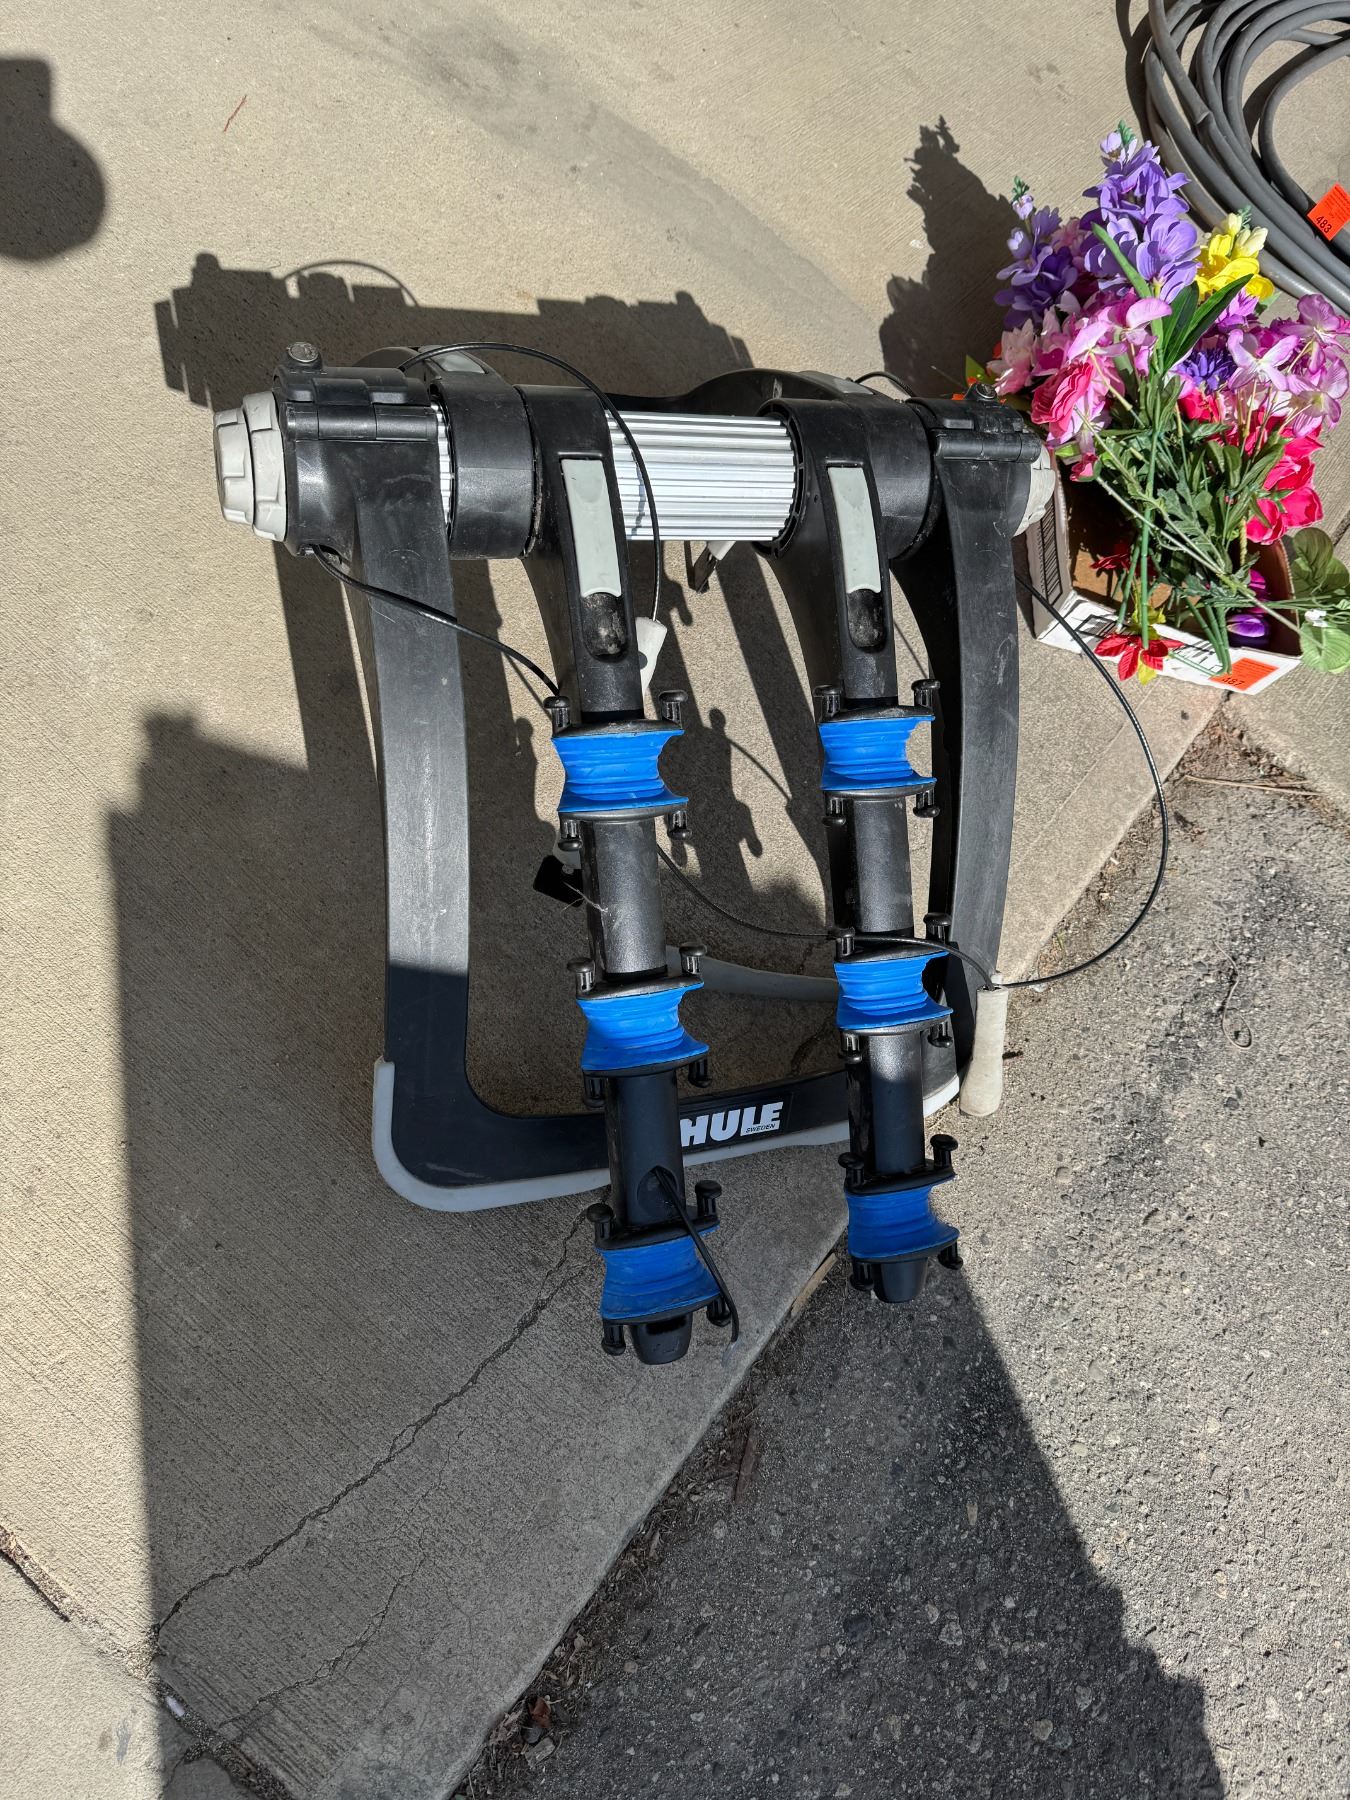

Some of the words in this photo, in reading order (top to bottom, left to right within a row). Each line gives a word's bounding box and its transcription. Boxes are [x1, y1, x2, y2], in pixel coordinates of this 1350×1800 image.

[1316, 215, 1333, 234] 483
[679, 1101, 784, 1147] HULE
[745, 1123, 776, 1134] SWEDEN
